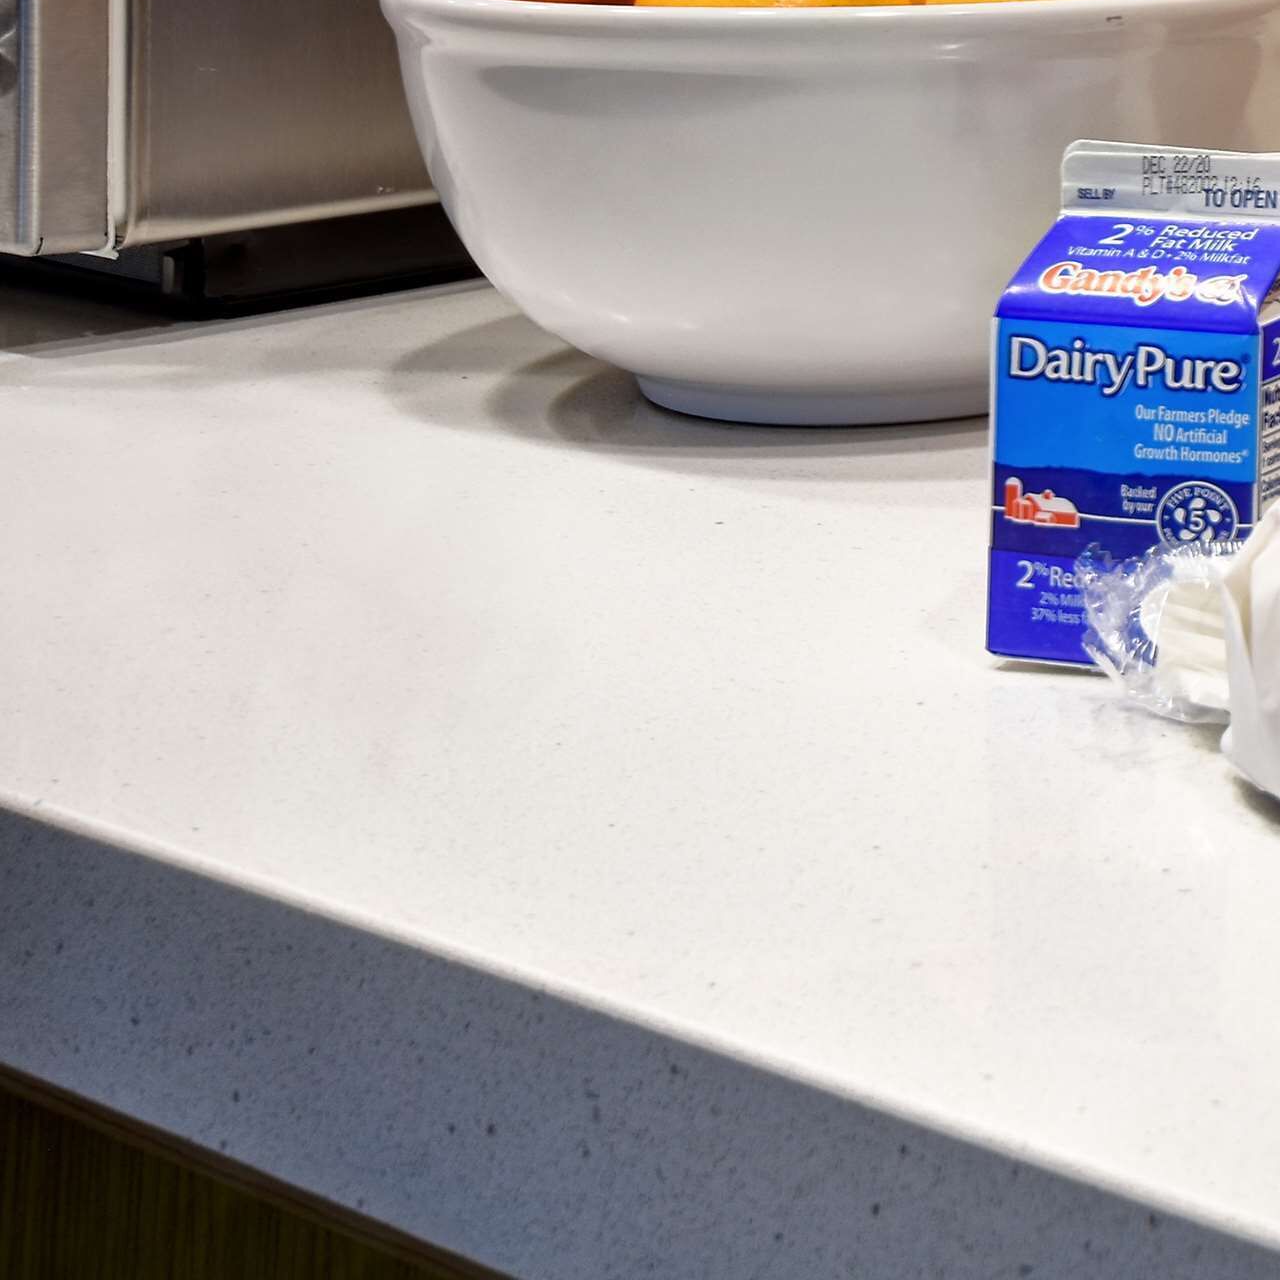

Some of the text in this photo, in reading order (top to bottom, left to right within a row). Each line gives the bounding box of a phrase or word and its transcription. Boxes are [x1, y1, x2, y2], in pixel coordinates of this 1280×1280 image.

[1142, 156, 1167, 174] DEC
[1077, 187, 1116, 200] SELL BY
[1203, 188, 1279, 209] TO OPEN
[1159, 224, 1259, 241] Reduced
[1150, 237, 1240, 252] Fat Milk
[1066, 245, 1122, 258] Vitamin
[1123, 247, 1136, 259] A
[1199, 251, 1251, 265] Milkfat
[1040, 261, 1198, 307] Gandy's
[1008, 334, 1243, 397] DairyPure
[1135, 403, 1250, 429] Our Farmers Pledge
[1153, 422, 1228, 444] NO Artificial
[1133, 443, 1178, 461] Growth
[1188, 510, 1206, 532] 5
